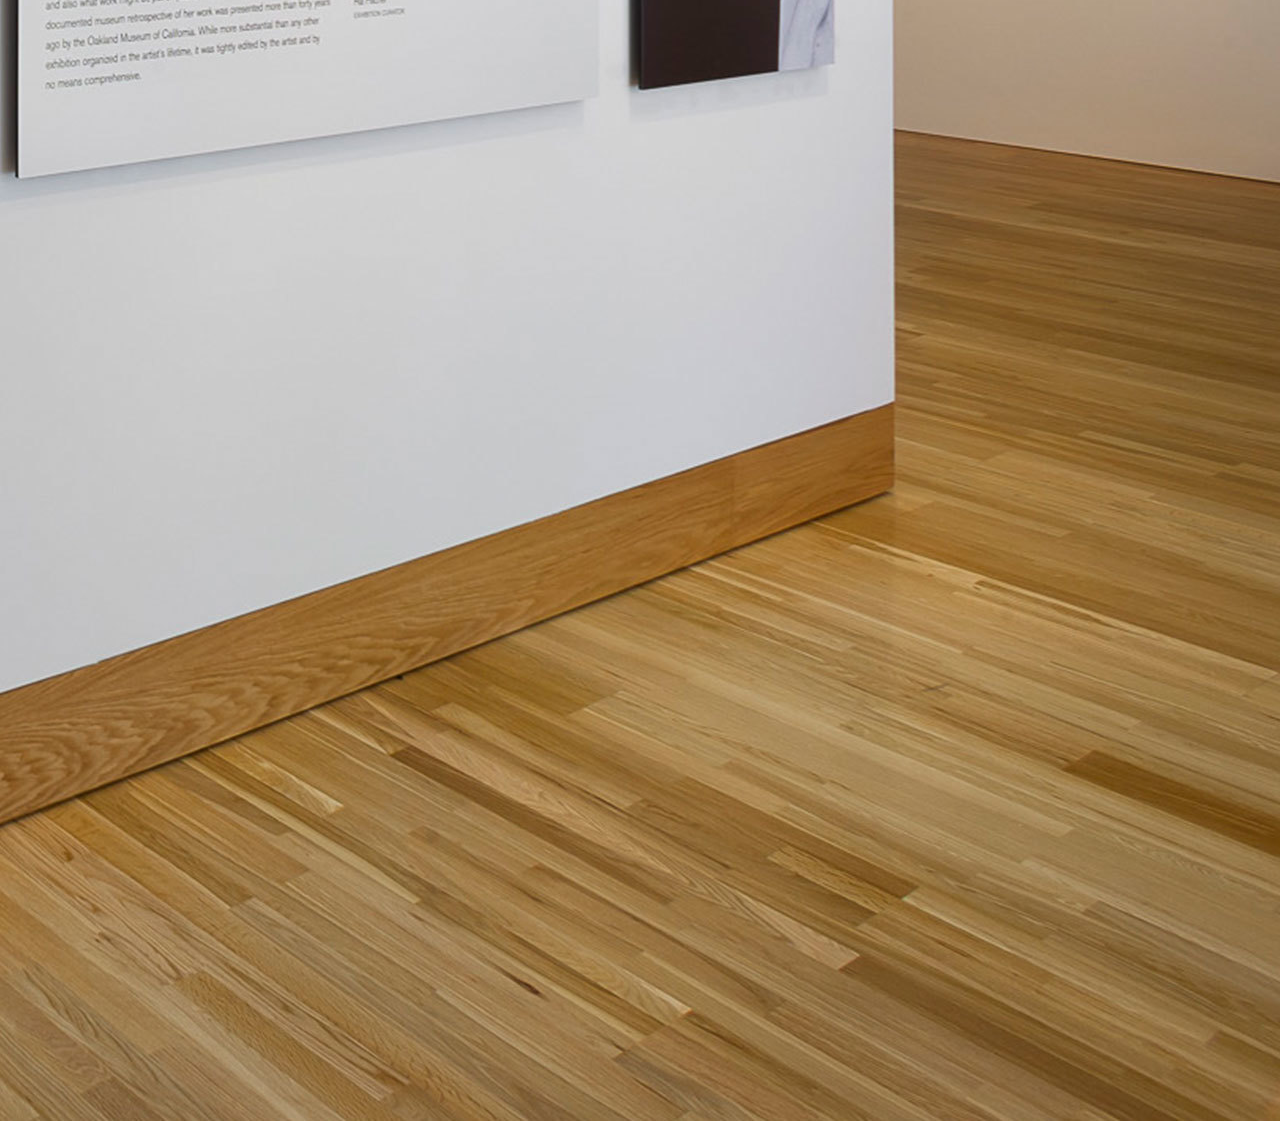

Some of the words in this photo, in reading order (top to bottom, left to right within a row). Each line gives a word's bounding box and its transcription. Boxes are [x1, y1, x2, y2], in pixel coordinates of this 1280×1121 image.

[45, 15, 92, 30] documented
[93, 15, 125, 25] museum
[126, 9, 172, 25] retrospective
[45, 40, 60, 52] ago
[61, 37, 71, 50] by
[72, 36, 85, 47] the
[86, 33, 118, 46] Oakland
[119, 30, 151, 43] Museum
[45, 56, 80, 69] exhibition
[81, 52, 118, 68] organized
[119, 51, 127, 62] in
[127, 50, 140, 61] the
[45, 81, 55, 90] no
[56, 78, 82, 88] means
